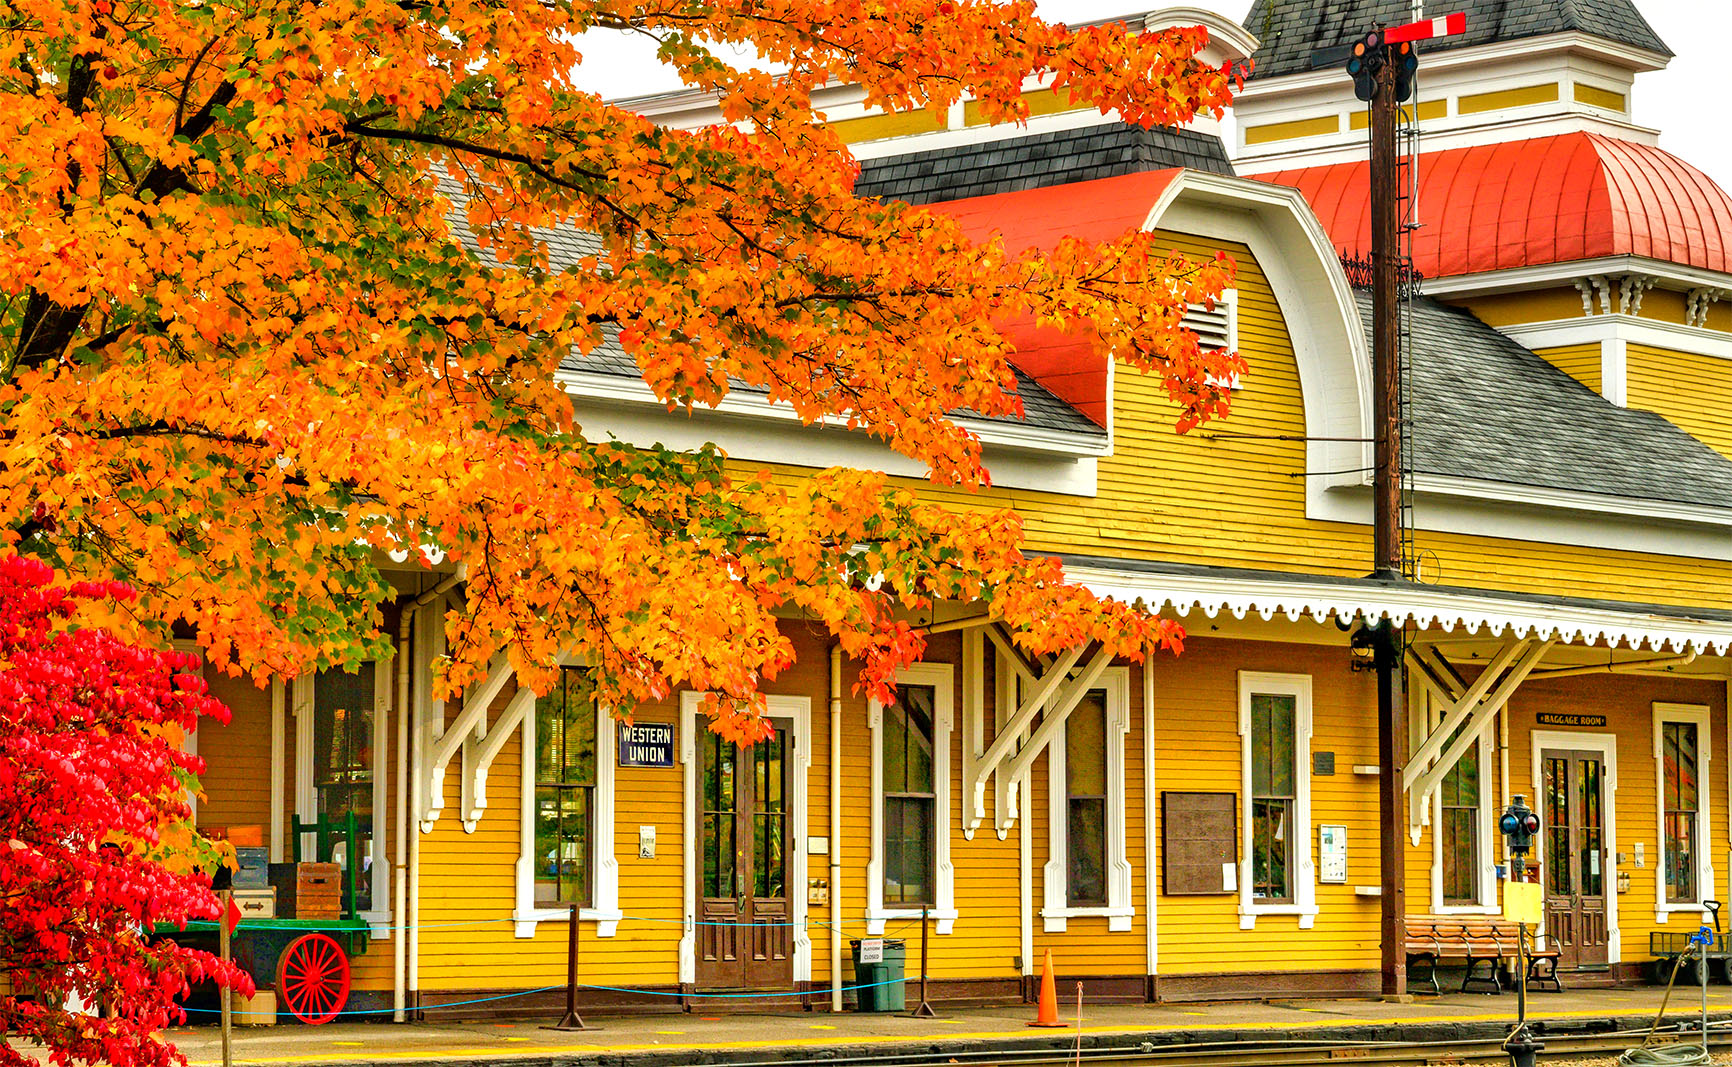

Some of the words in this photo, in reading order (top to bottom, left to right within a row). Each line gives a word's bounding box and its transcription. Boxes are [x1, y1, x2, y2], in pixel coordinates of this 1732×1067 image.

[1544, 714, 1579, 724] BAGGAGE
[1580, 716, 1602, 725] ROOM
[622, 726, 671, 744] WESTERN
[629, 745, 665, 763] UNION
